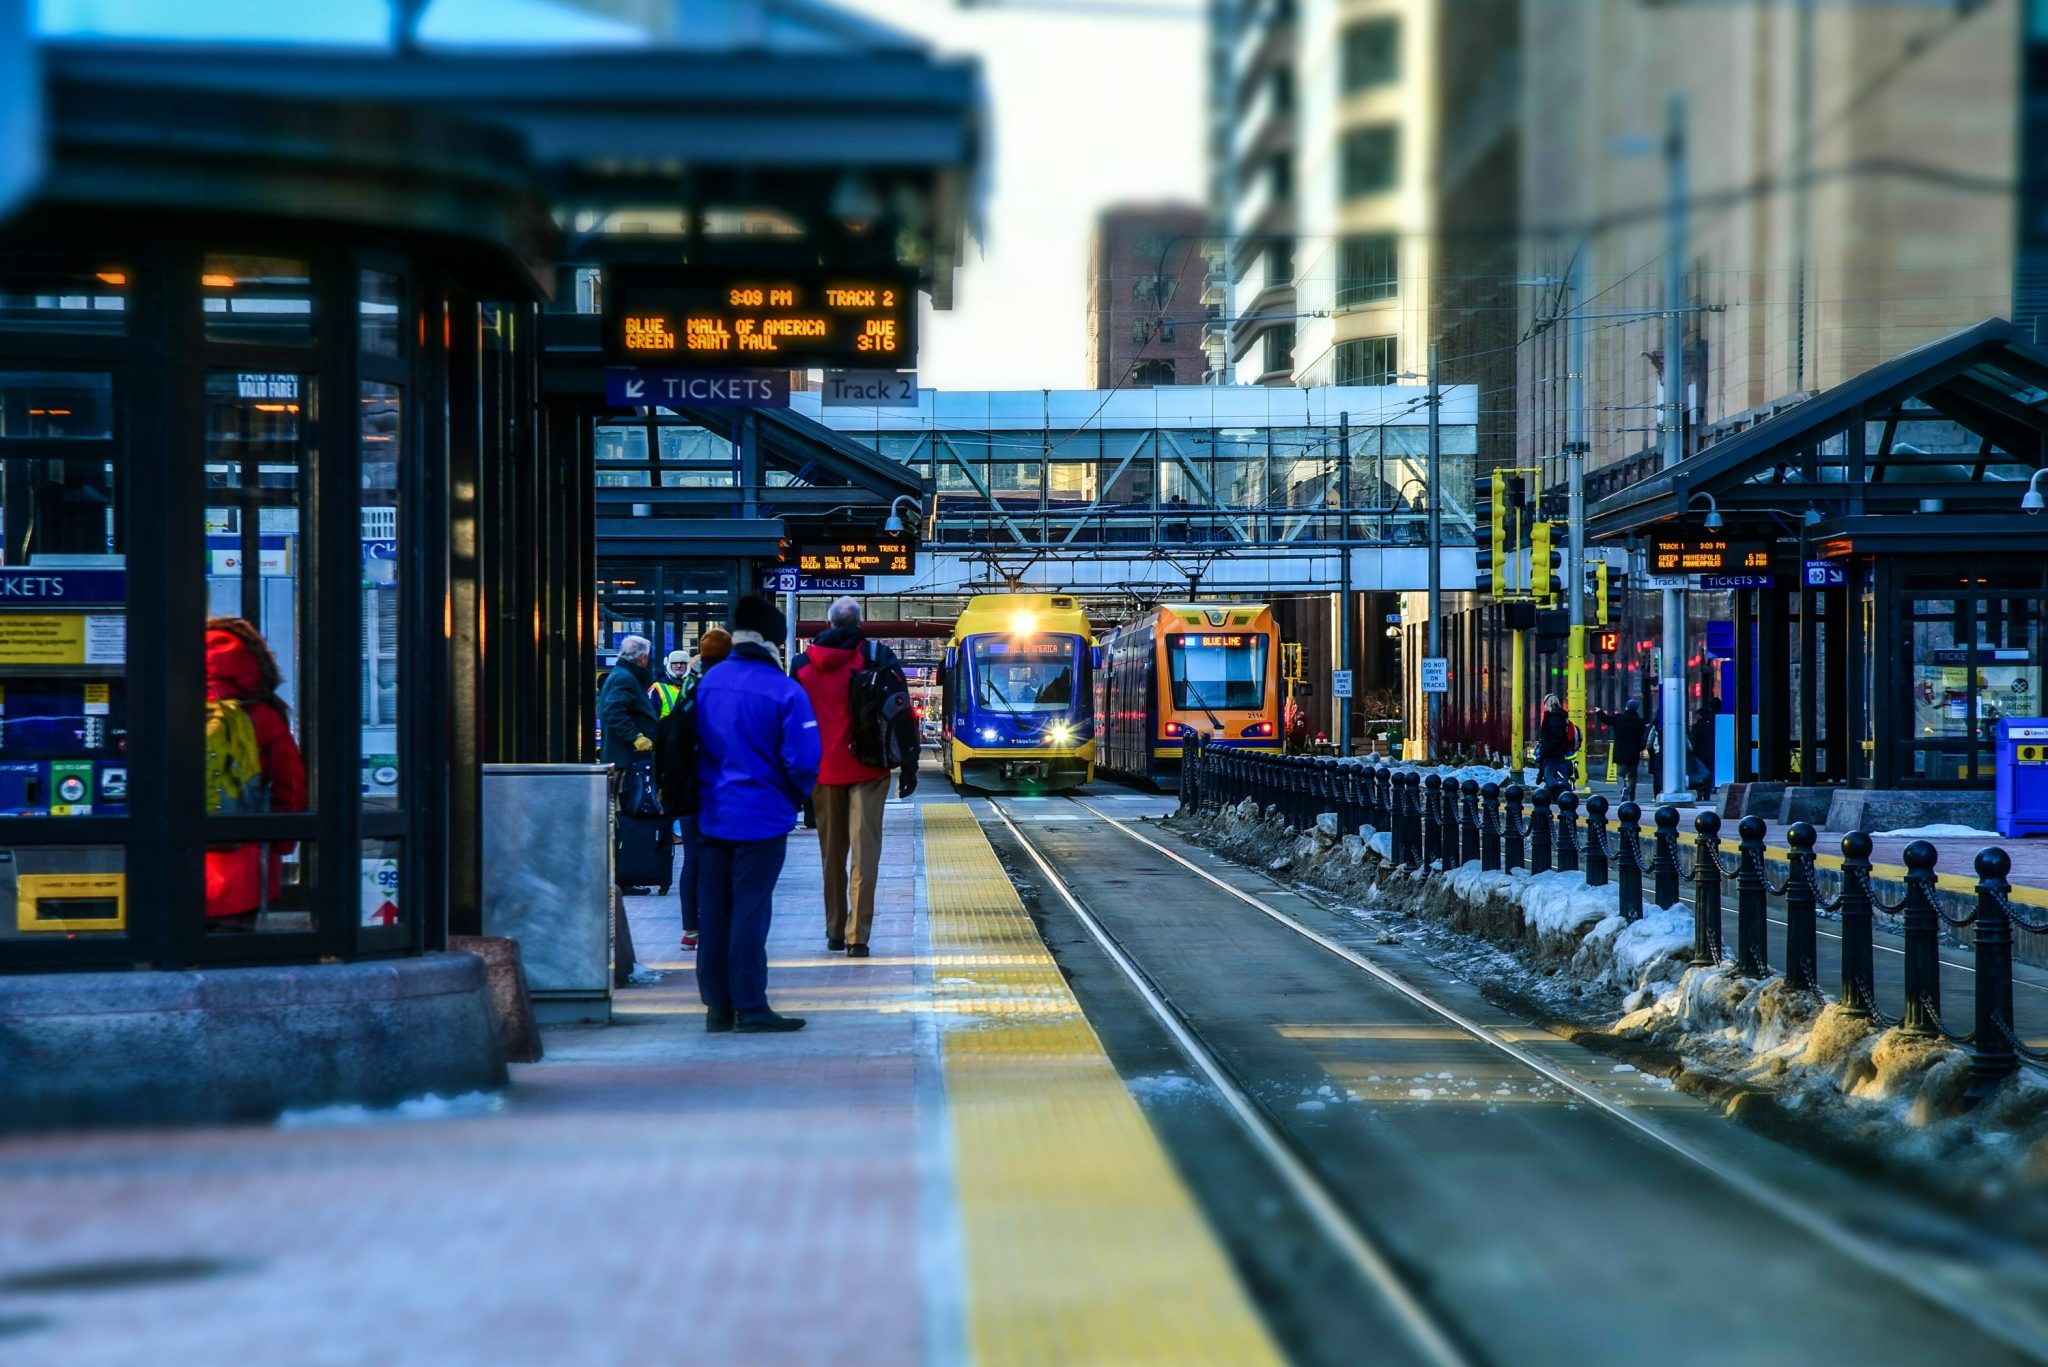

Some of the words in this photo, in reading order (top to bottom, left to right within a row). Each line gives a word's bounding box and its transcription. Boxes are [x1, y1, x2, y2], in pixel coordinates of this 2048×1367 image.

[730, 289, 763, 306] 3:09
[770, 289, 793, 306] PM
[826, 289, 875, 306] TRACK
[882, 290, 894, 307] 2
[625, 317, 665, 334] BLUE
[686, 318, 728, 334] MALL
[735, 319, 756, 335] OF
[763, 319, 826, 336] AMERICA
[866, 320, 895, 336] DUE
[625, 333, 674, 349] GREEN
[687, 334, 731, 350] SAINT
[739, 334, 777, 350] PAUL
[239, 382, 267, 398] VALID
[268, 382, 292, 398] FARE
[663, 379, 773, 400] TICKETS
[831, 379, 891, 400] Track
[899, 379, 912, 399] 2
[825, 556, 841, 564] MALL
[844, 556, 852, 564] OF
[854, 556, 879, 564] AMERICA
[0, 577, 64, 596] KETS
[815, 579, 858, 588] TICKETS
[1655, 577, 1678, 586] Track
[1708, 576, 1753, 586] TICKETS
[1203, 637, 1221, 646] BLUE
[1223, 637, 1240, 646] LINE
[1601, 634, 1617, 650] 12
